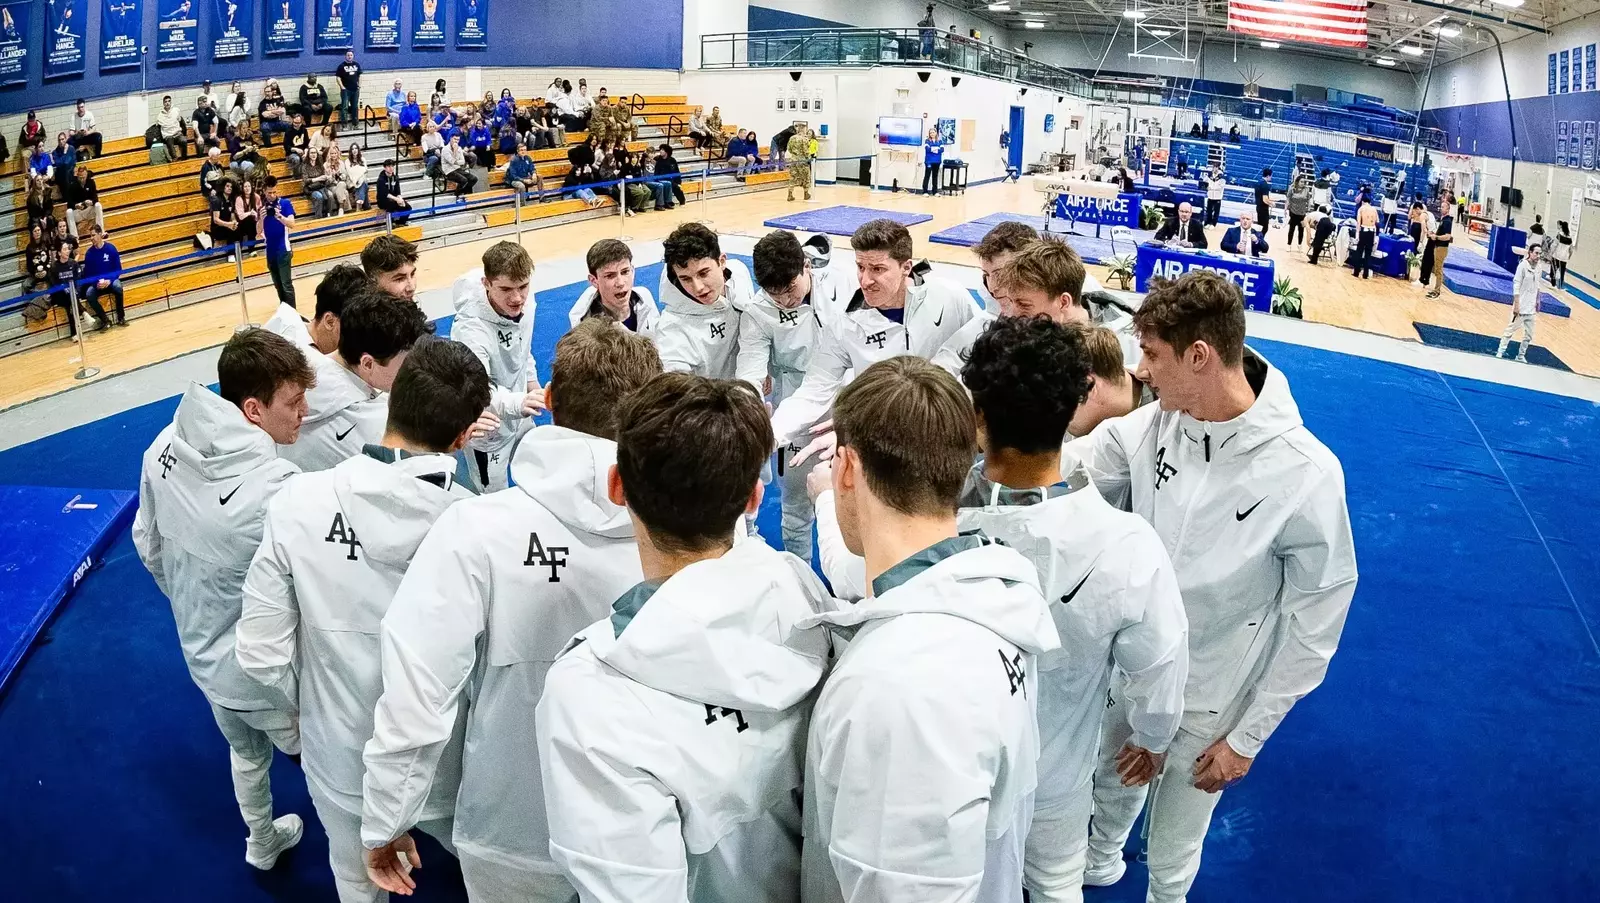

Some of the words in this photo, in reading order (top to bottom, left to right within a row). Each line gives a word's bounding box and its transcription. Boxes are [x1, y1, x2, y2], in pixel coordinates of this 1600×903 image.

[1357, 148, 1392, 161] CALIFORNIA
[1066, 195, 1084, 208] AIR
[1087, 197, 1129, 213] FORCE
[1152, 258, 1184, 281] AIR
[778, 310, 798, 326] AF
[497, 330, 513, 348] AF
[709, 322, 726, 339] AF
[865, 331, 887, 349] AF
[158, 442, 178, 480] AF
[523, 532, 570, 583] AF
